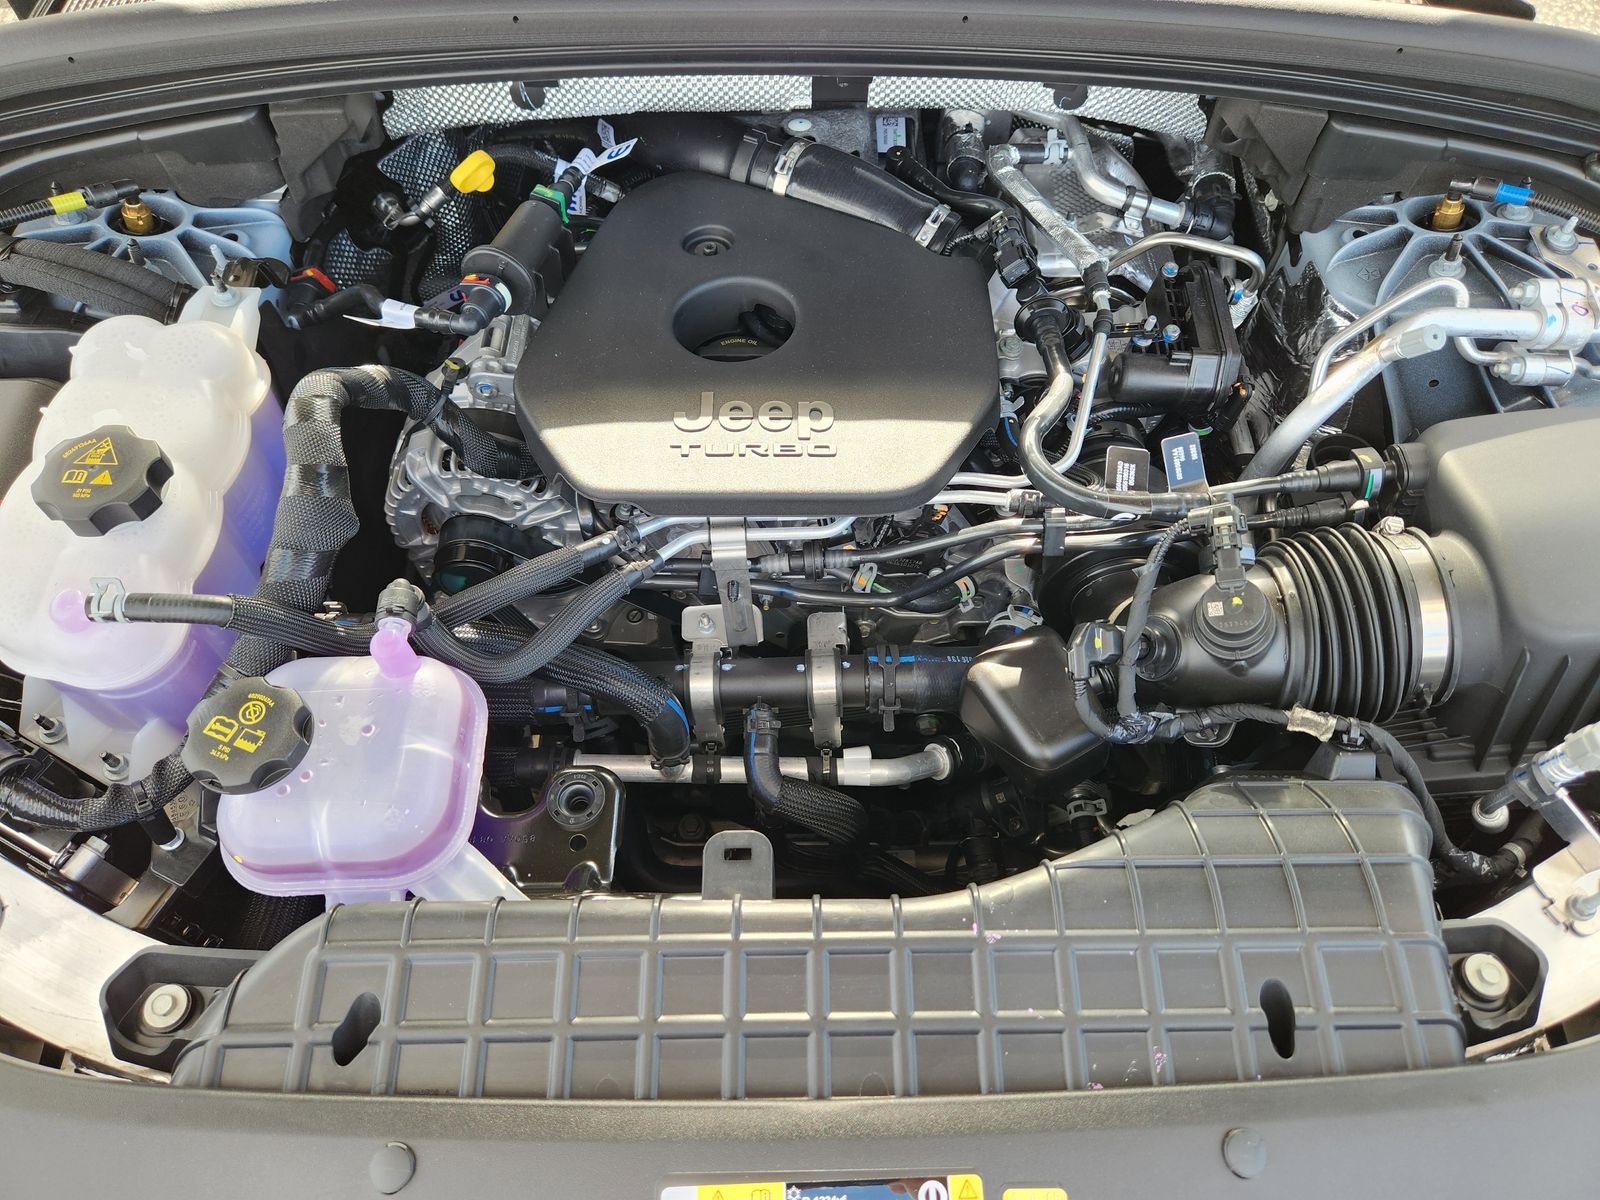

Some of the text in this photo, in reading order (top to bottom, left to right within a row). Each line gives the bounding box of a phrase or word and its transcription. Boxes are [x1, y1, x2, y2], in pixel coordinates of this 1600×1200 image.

[720, 338, 747, 346] ENGINE
[673, 391, 835, 441] Jeep
[670, 443, 837, 458] TURBO
